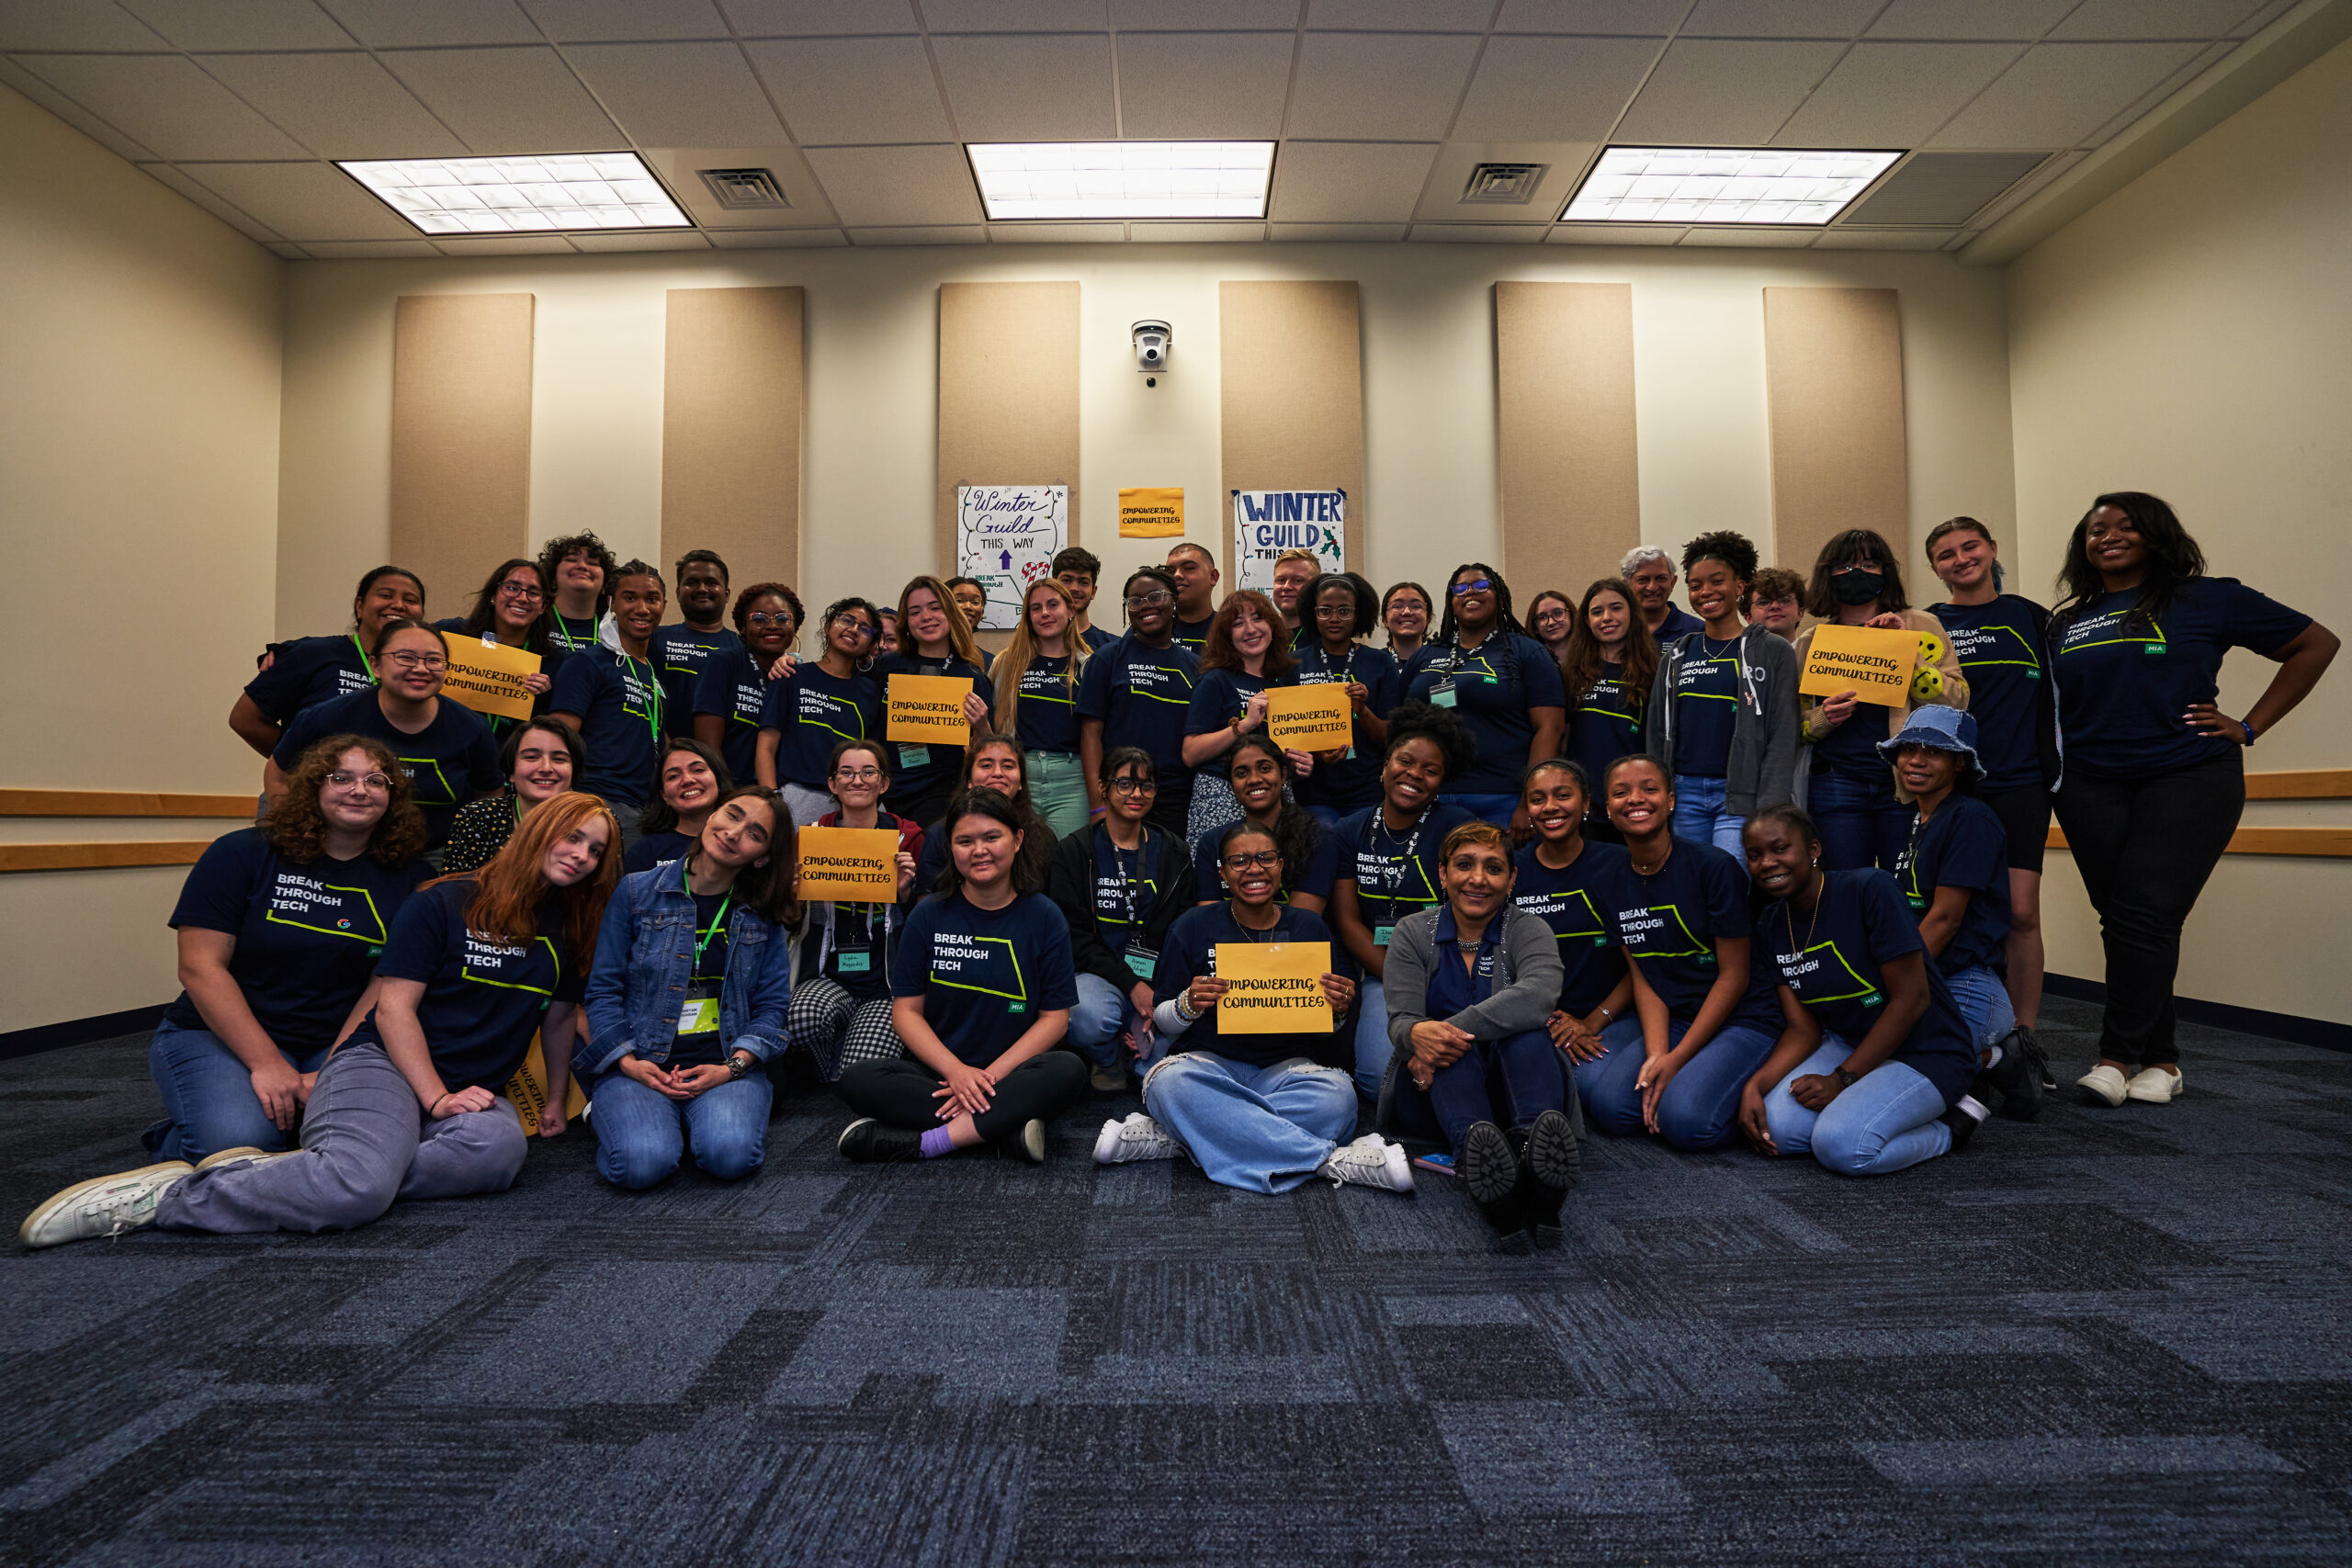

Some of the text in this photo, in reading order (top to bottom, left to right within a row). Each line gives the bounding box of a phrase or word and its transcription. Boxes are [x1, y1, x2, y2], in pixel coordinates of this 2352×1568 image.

[974, 490, 1048, 512] Winter
[1243, 492, 1341, 522] WINTER
[1122, 506, 1175, 514] EMPOWERING
[976, 514, 1051, 534] Guild
[1122, 516, 1181, 525] COMMUNITIES
[1256, 525, 1320, 547] GUILD
[980, 537, 1035, 549] THIS WAY
[2066, 617, 2121, 637] THROUGH
[2069, 614, 2107, 629] BREAK
[1951, 636, 1996, 648] HROUGH
[2064, 630, 2090, 645] TECH
[666, 640, 695, 649] BREAK
[666, 647, 707, 658] THROUGH
[1955, 646, 1977, 657] ECH
[1812, 649, 1899, 671] EMPOWERING
[1127, 663, 1157, 671] BREAK
[1679, 667, 1718, 677] HROUGH
[447, 661, 524, 687] MPOWERING
[1128, 671, 1169, 682] THROUGH
[1299, 671, 1327, 680] BREAK
[1809, 664, 1904, 686] COMMUNITIES
[1130, 678, 1153, 686] TECH
[1679, 677, 1695, 686] ECH
[444, 676, 529, 701] OMMUNITIES
[799, 688, 829, 701] BREAK
[1592, 685, 1619, 694] OUGH
[625, 694, 643, 705] TECH
[737, 693, 763, 706] THRO
[799, 696, 842, 713] THROUGH
[736, 702, 760, 715] TECH
[798, 705, 823, 715] TECH
[891, 700, 959, 715] EMPOWERING
[891, 714, 965, 727] COMMUNITIES
[1272, 708, 1341, 724] EMPOWERING
[1272, 721, 1347, 737] COMMUNITIES
[803, 855, 884, 871] EMPOWERING
[1357, 852, 1390, 864] BREAK
[277, 874, 324, 891] BREAK
[803, 871, 891, 884] COMMUNITIES
[1097, 877, 1121, 887] REAK
[1357, 875, 1378, 885] TECH
[275, 886, 342, 907] THROUGH
[1097, 888, 1136, 898] HROUH
[271, 898, 309, 912] TECH
[1097, 899, 1116, 909] ECH
[1516, 894, 1550, 906] BREAK
[1520, 903, 1566, 914] ROUGH
[1619, 908, 1649, 920] BREAK
[1620, 918, 1665, 933] THROUGH
[933, 932, 973, 945] BREAK
[1623, 932, 1645, 945] TECH
[465, 940, 526, 957] THROUGH
[933, 946, 989, 960] THROUGH
[464, 953, 502, 968] TECH
[1776, 951, 1804, 964] REAK
[933, 960, 961, 971] TECH
[1782, 960, 1819, 977] ROUGH
[1229, 978, 1316, 992] MPOWERING
[1223, 996, 1325, 1009] COMMUNITIES
[1864, 996, 1880, 1005] MIA
[519, 1063, 546, 1114] OWERING
[507, 1077, 538, 1127] UNITIES
